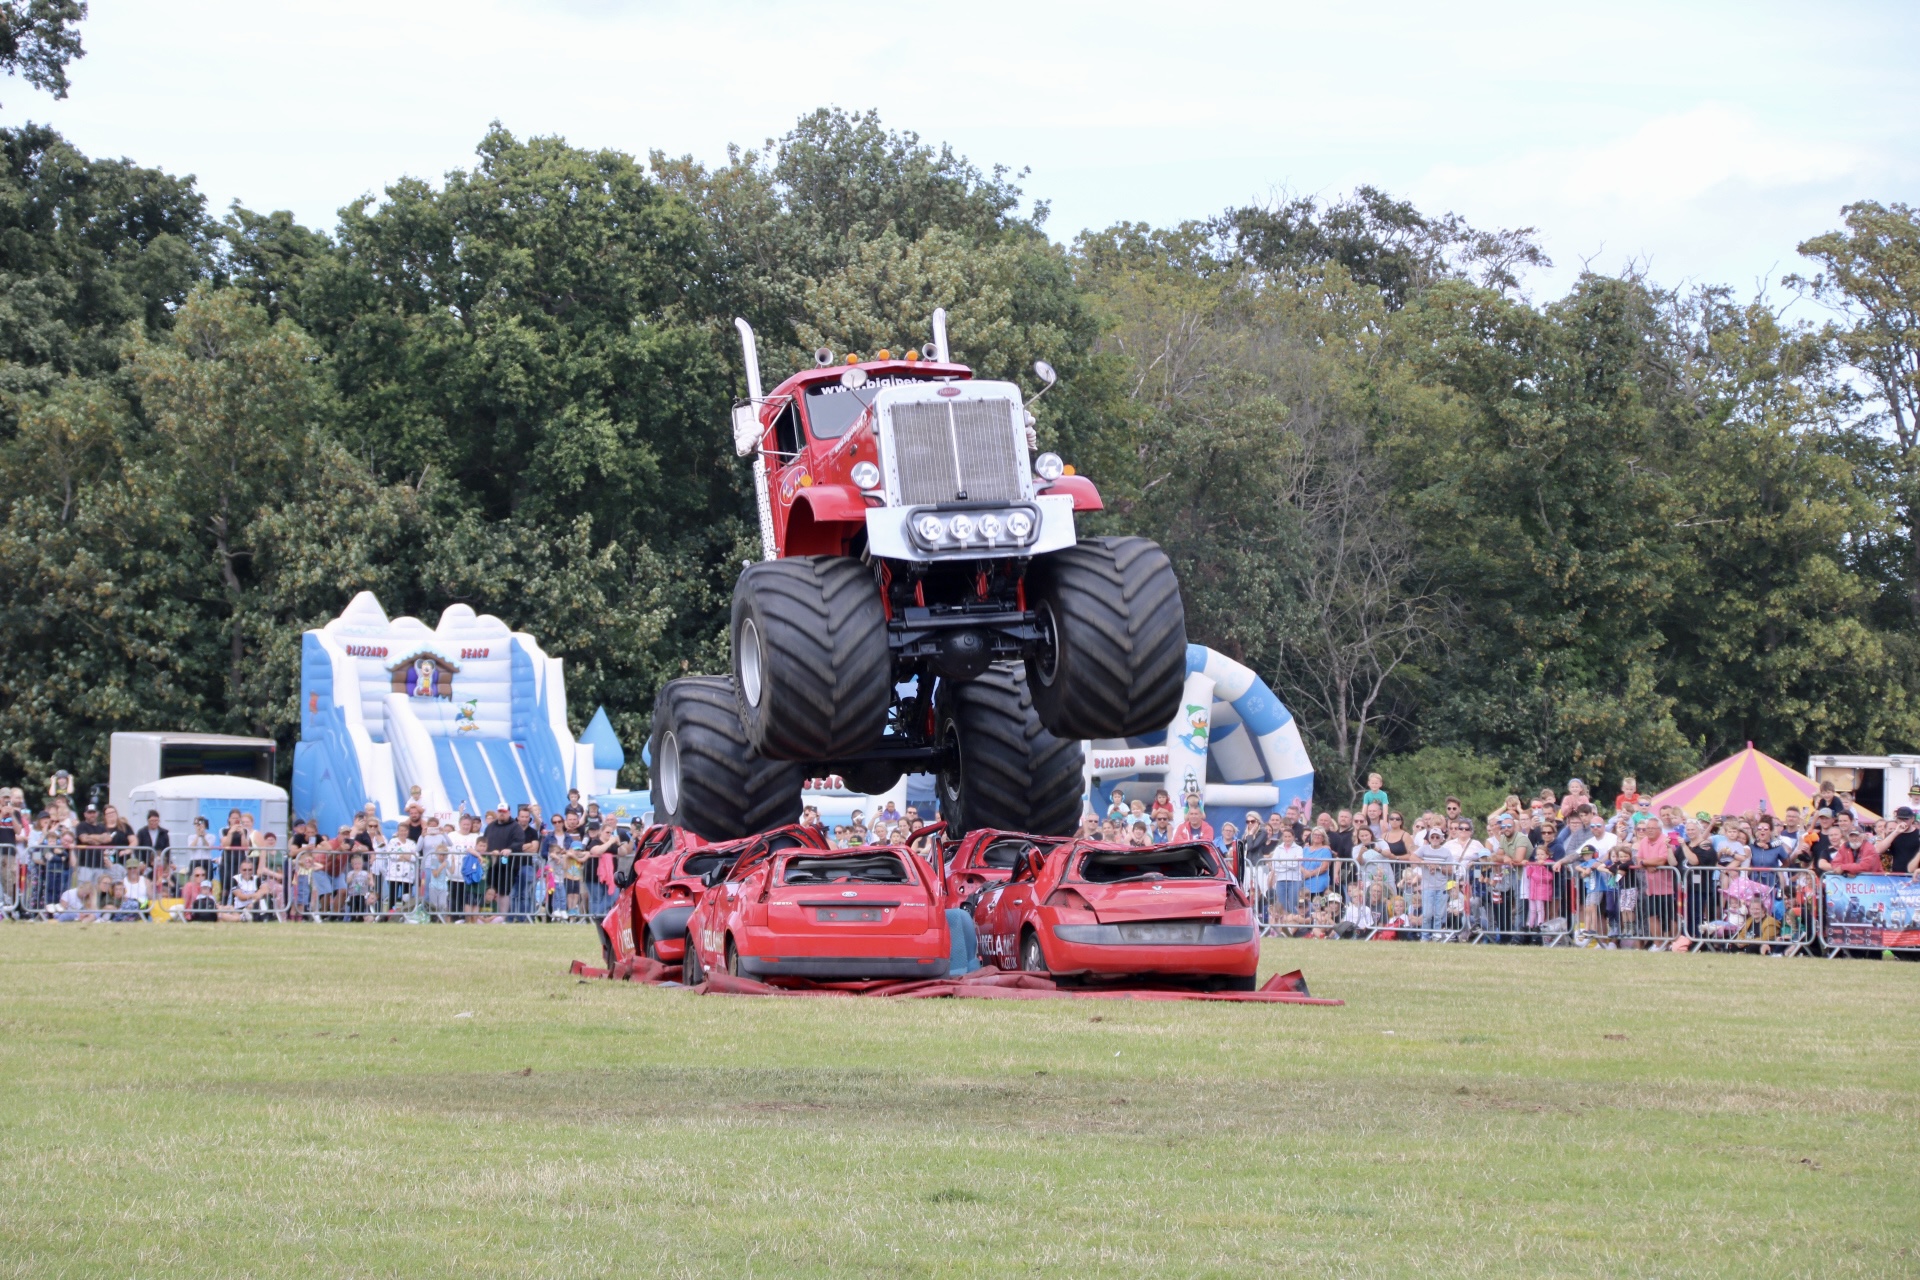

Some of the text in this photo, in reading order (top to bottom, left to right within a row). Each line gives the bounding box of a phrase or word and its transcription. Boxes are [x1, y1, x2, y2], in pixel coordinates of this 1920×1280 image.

[346, 644, 489, 659] BLIZZARD BEACH
[1094, 756, 1136, 769] BLIZZARD
[803, 776, 843, 790] BEAC
[434, 812, 452, 820] EXIT
